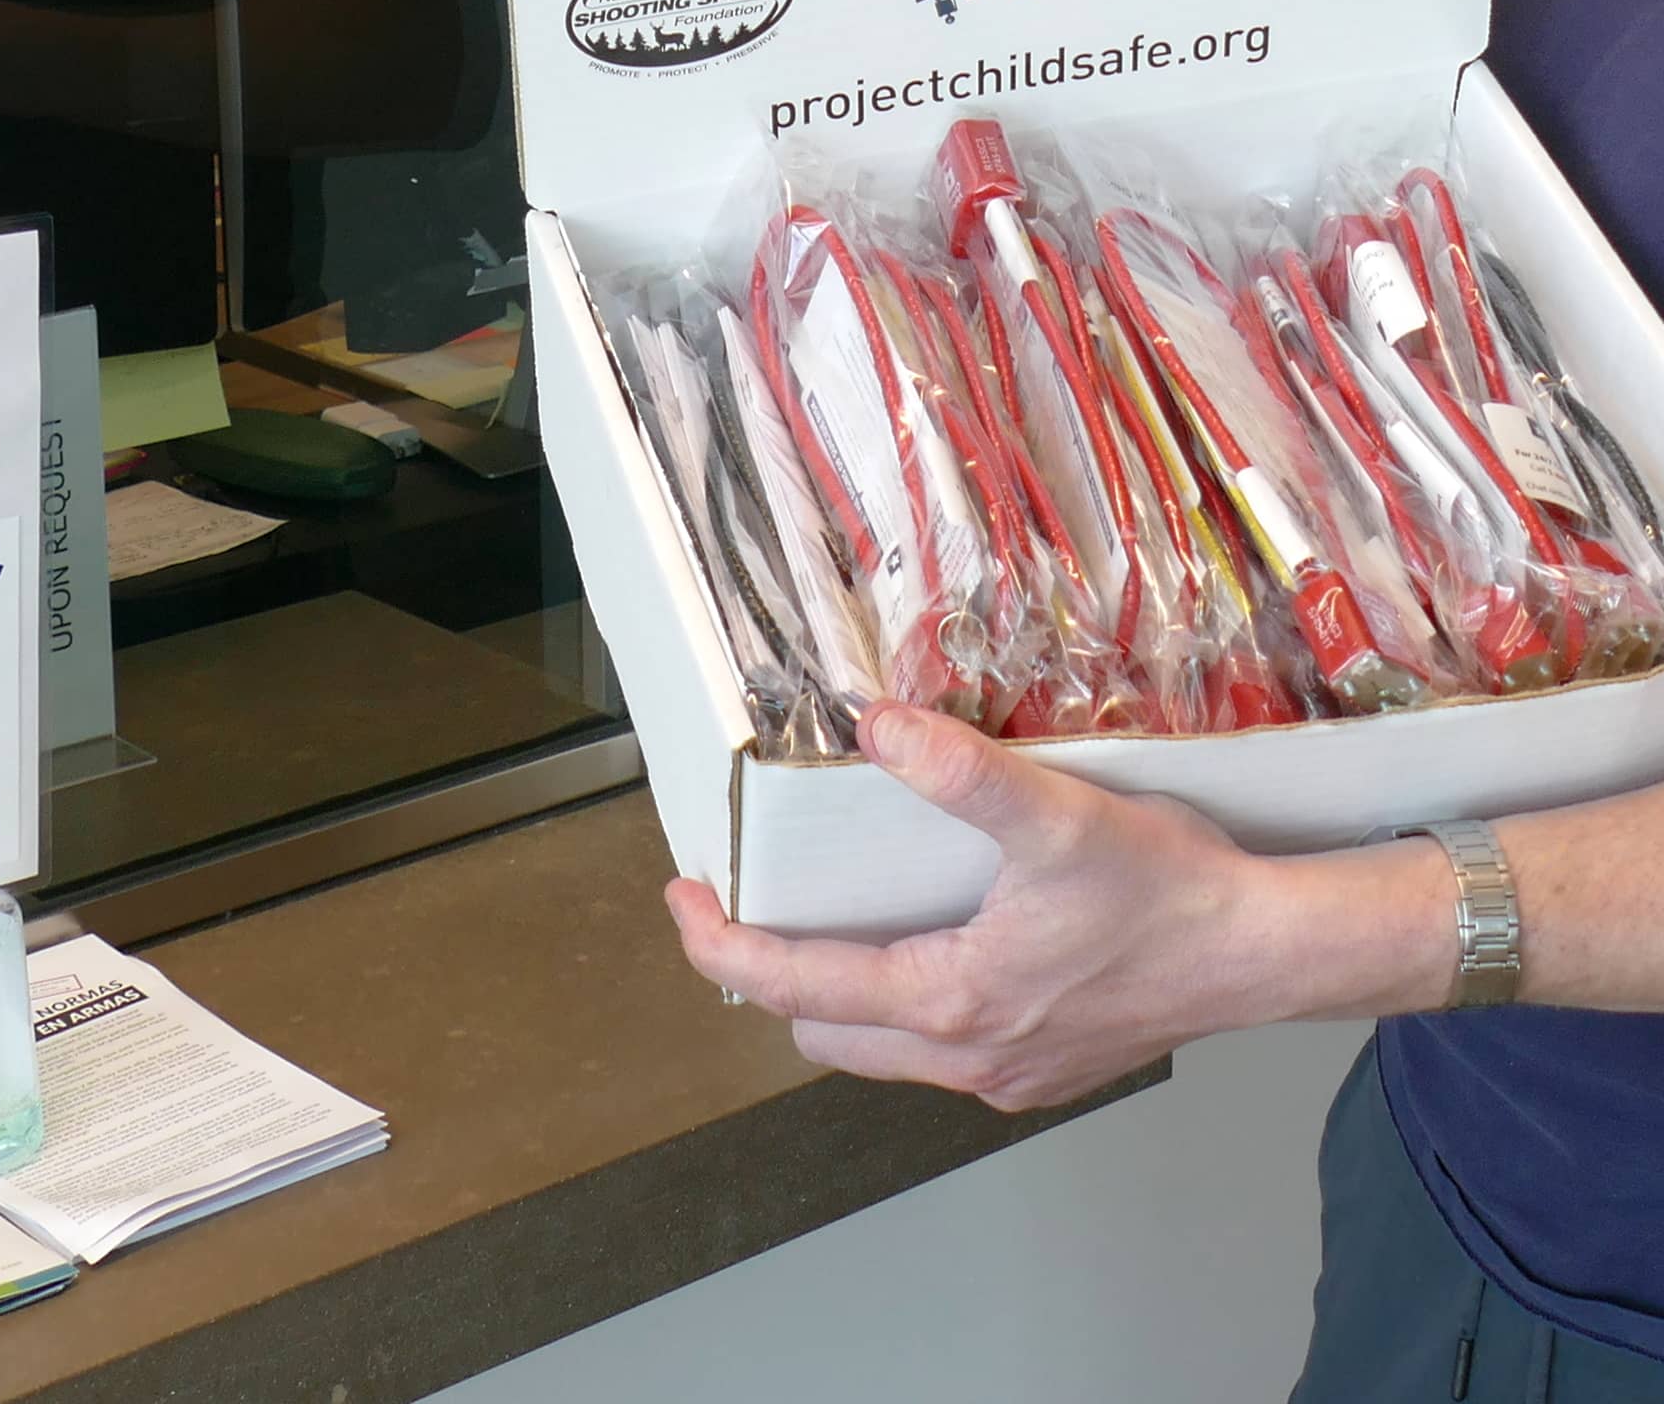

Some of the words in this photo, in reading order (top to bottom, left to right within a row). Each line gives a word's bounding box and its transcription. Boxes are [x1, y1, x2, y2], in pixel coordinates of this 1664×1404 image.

[674, 2, 765, 27] Foundation
[588, 60, 640, 79] PROMOTE
[658, 63, 709, 79] PROTECT
[725, 29, 779, 64] PRESERVE
[768, 21, 1274, 137] projectchildsafe.org
[47, 564, 74, 653] UPON
[35, 979, 124, 1019] NORMAS
[36, 1018, 67, 1037] EN
[71, 987, 142, 1024] ARMAS
